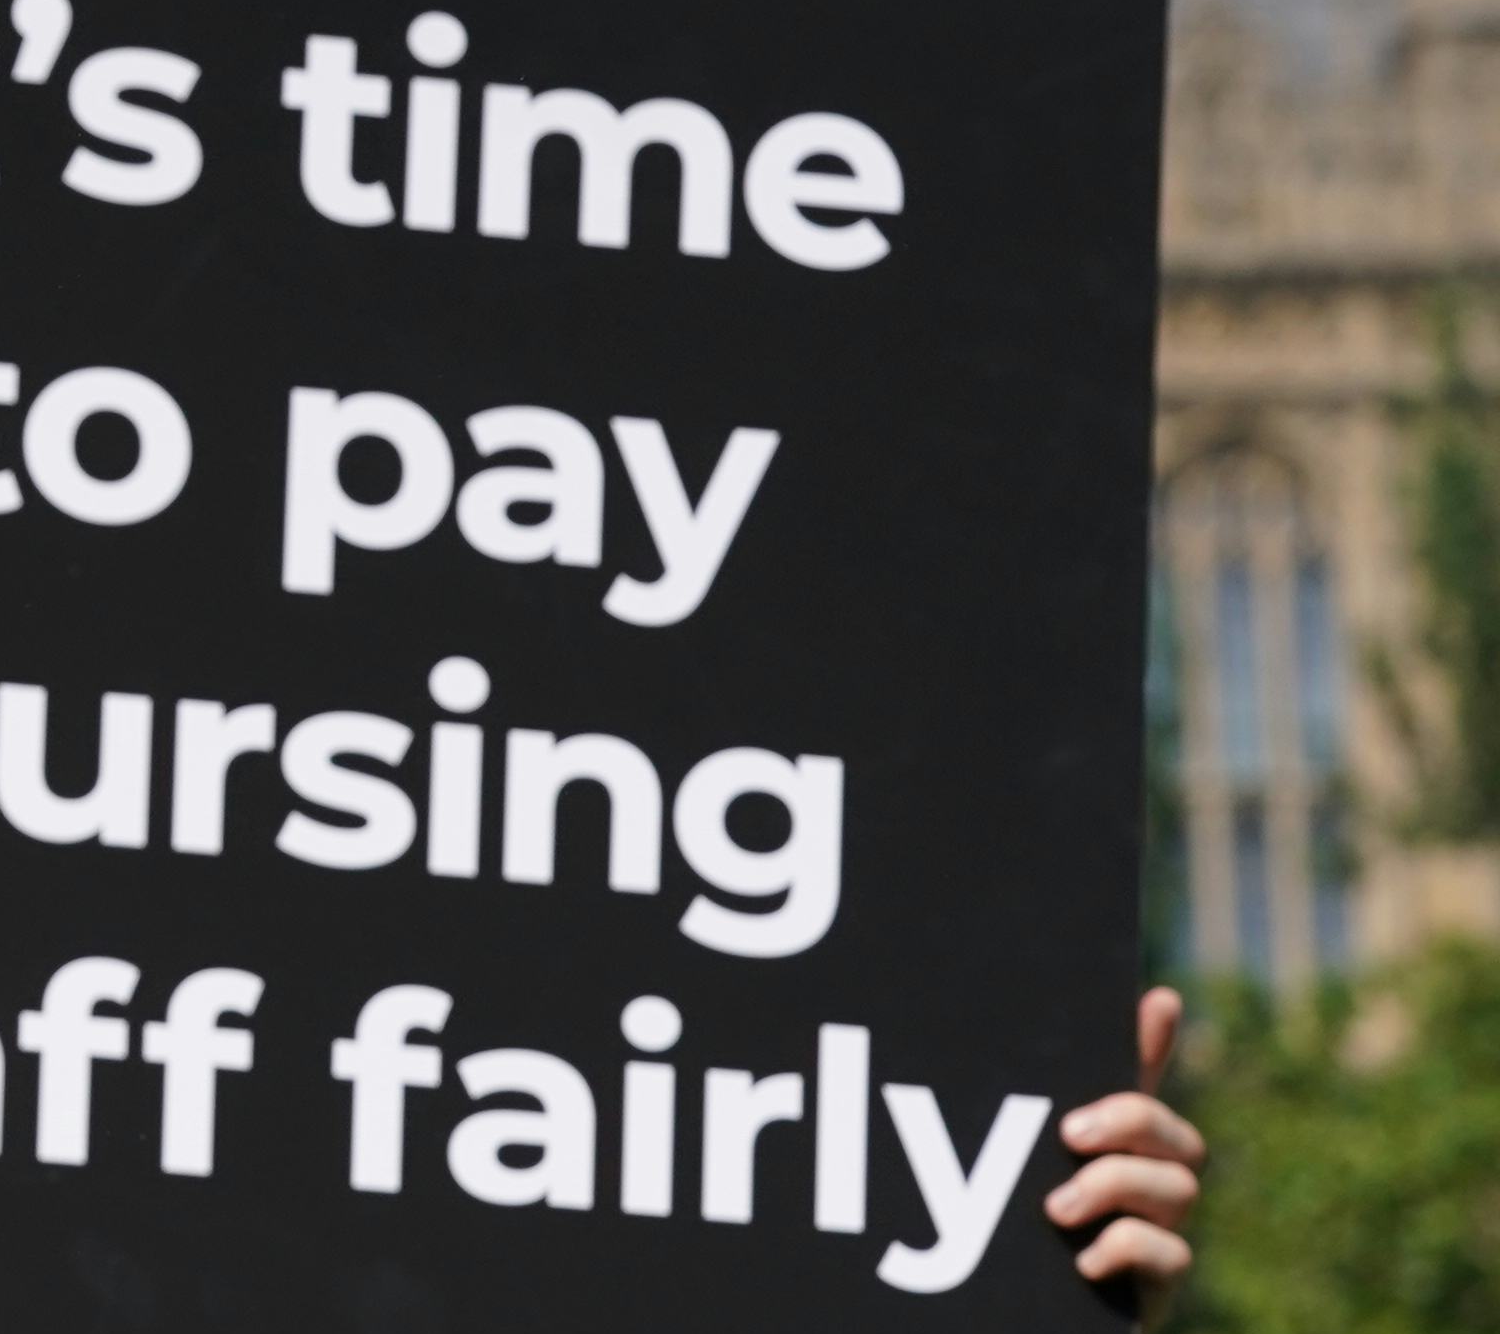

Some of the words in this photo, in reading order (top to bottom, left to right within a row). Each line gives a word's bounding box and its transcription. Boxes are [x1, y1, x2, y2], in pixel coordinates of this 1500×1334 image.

[281, 12, 904, 270] time
[282, 386, 780, 627] pay
[331, 984, 1051, 1294] fairly
